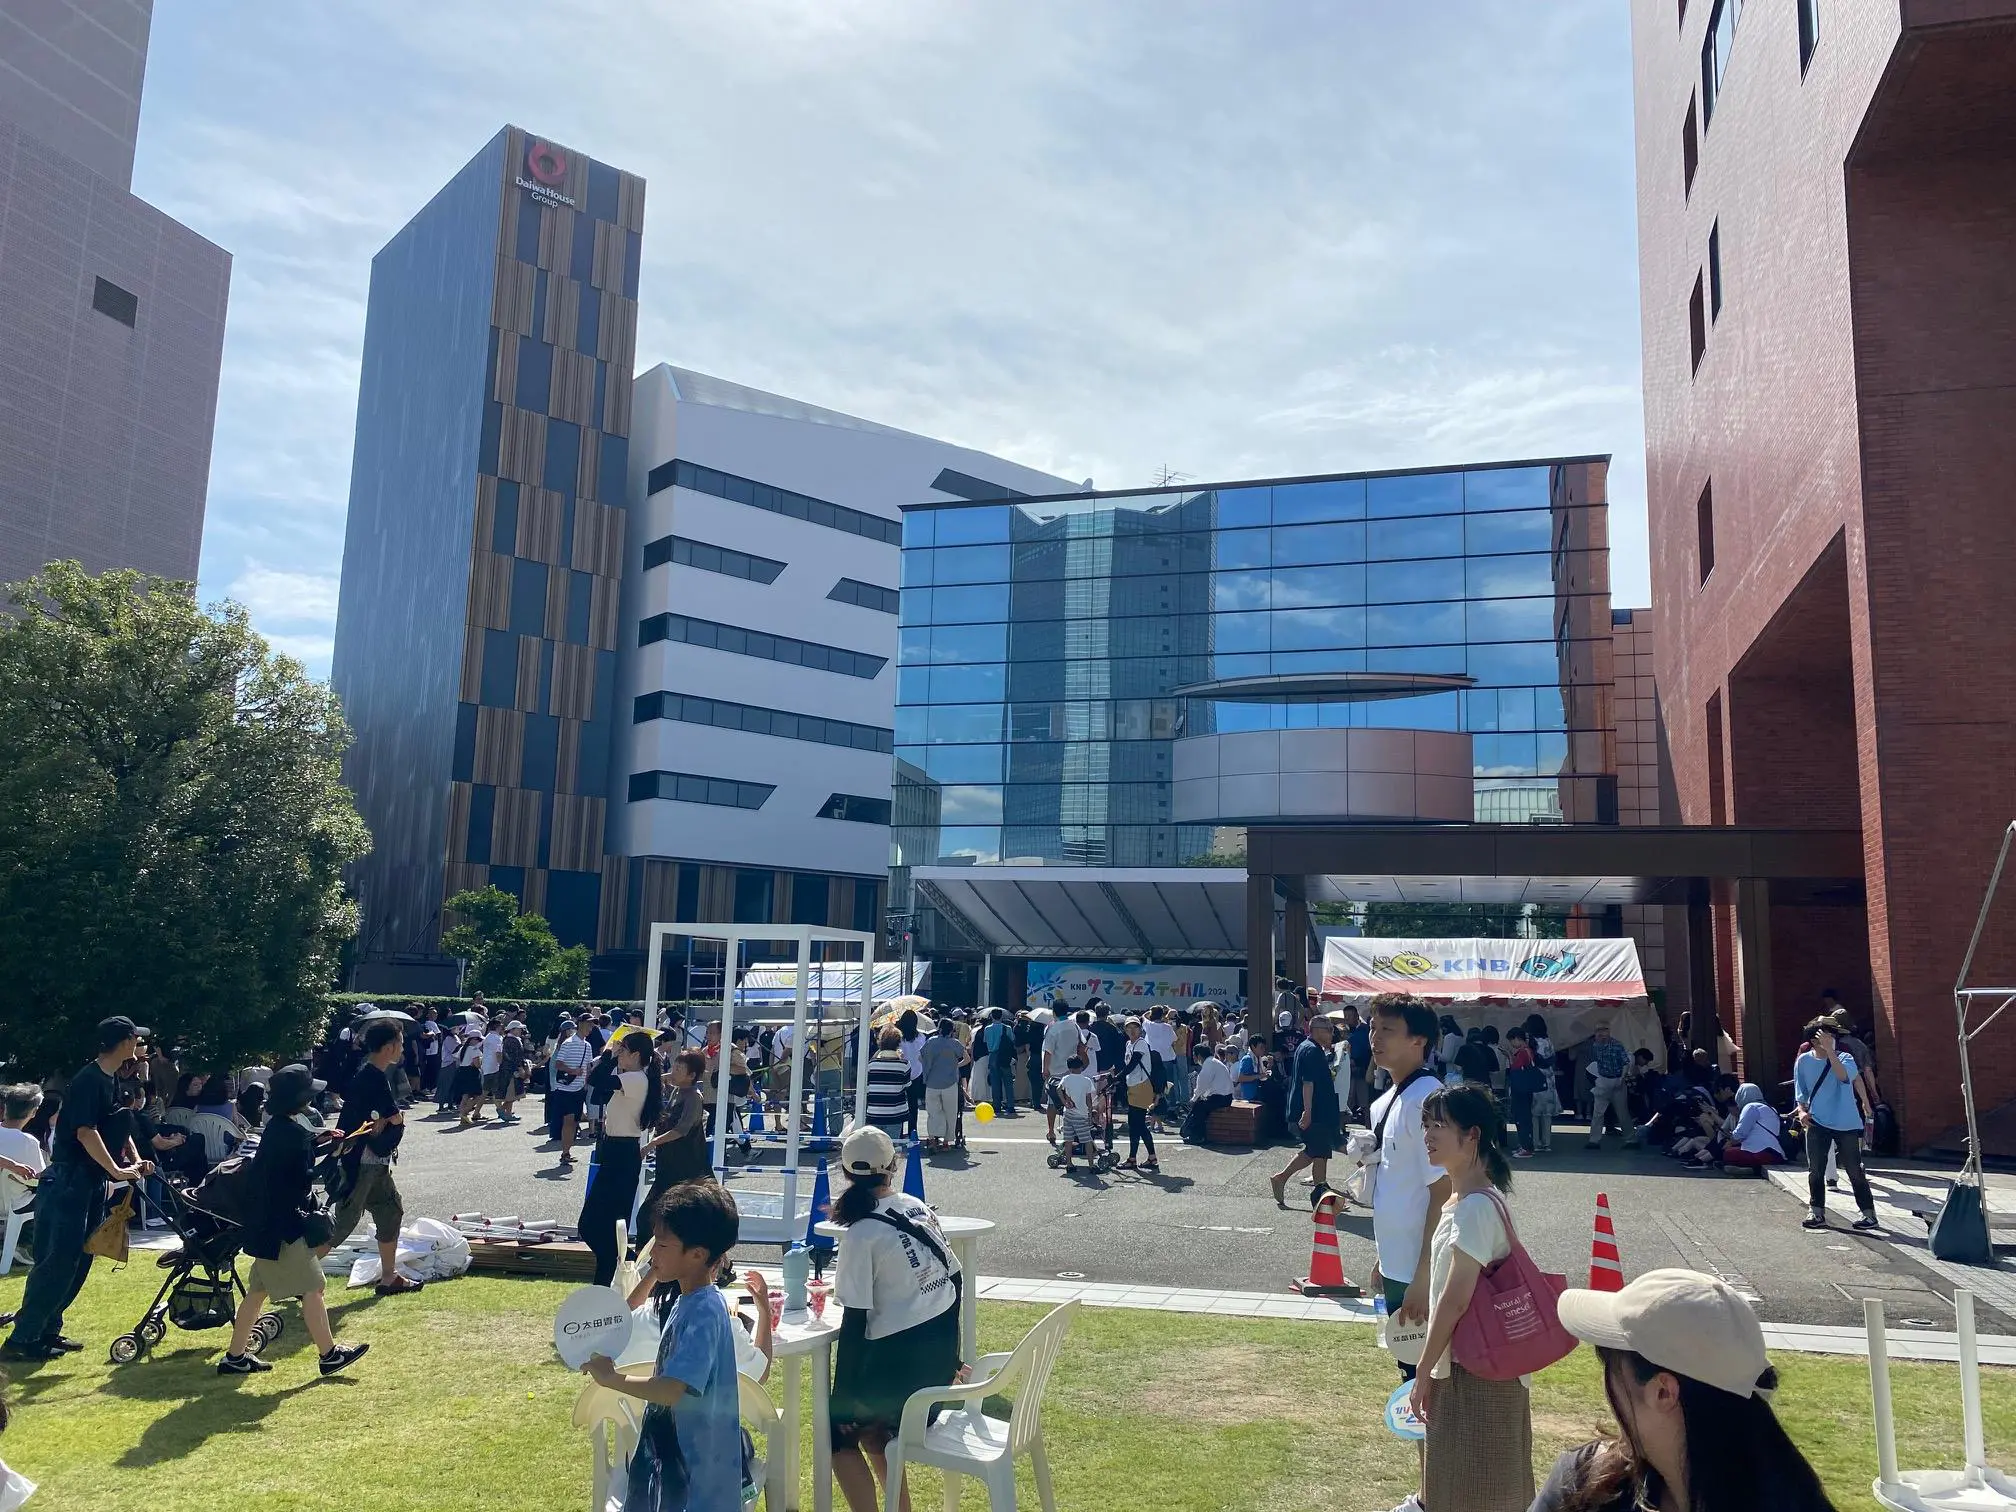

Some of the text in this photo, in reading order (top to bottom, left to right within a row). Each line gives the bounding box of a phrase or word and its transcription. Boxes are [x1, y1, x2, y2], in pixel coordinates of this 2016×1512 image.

[532, 192, 558, 209] Group
[1444, 959, 1510, 973] KNB
[1070, 978, 1227, 998] KNB サマーフェスティバル 2024
